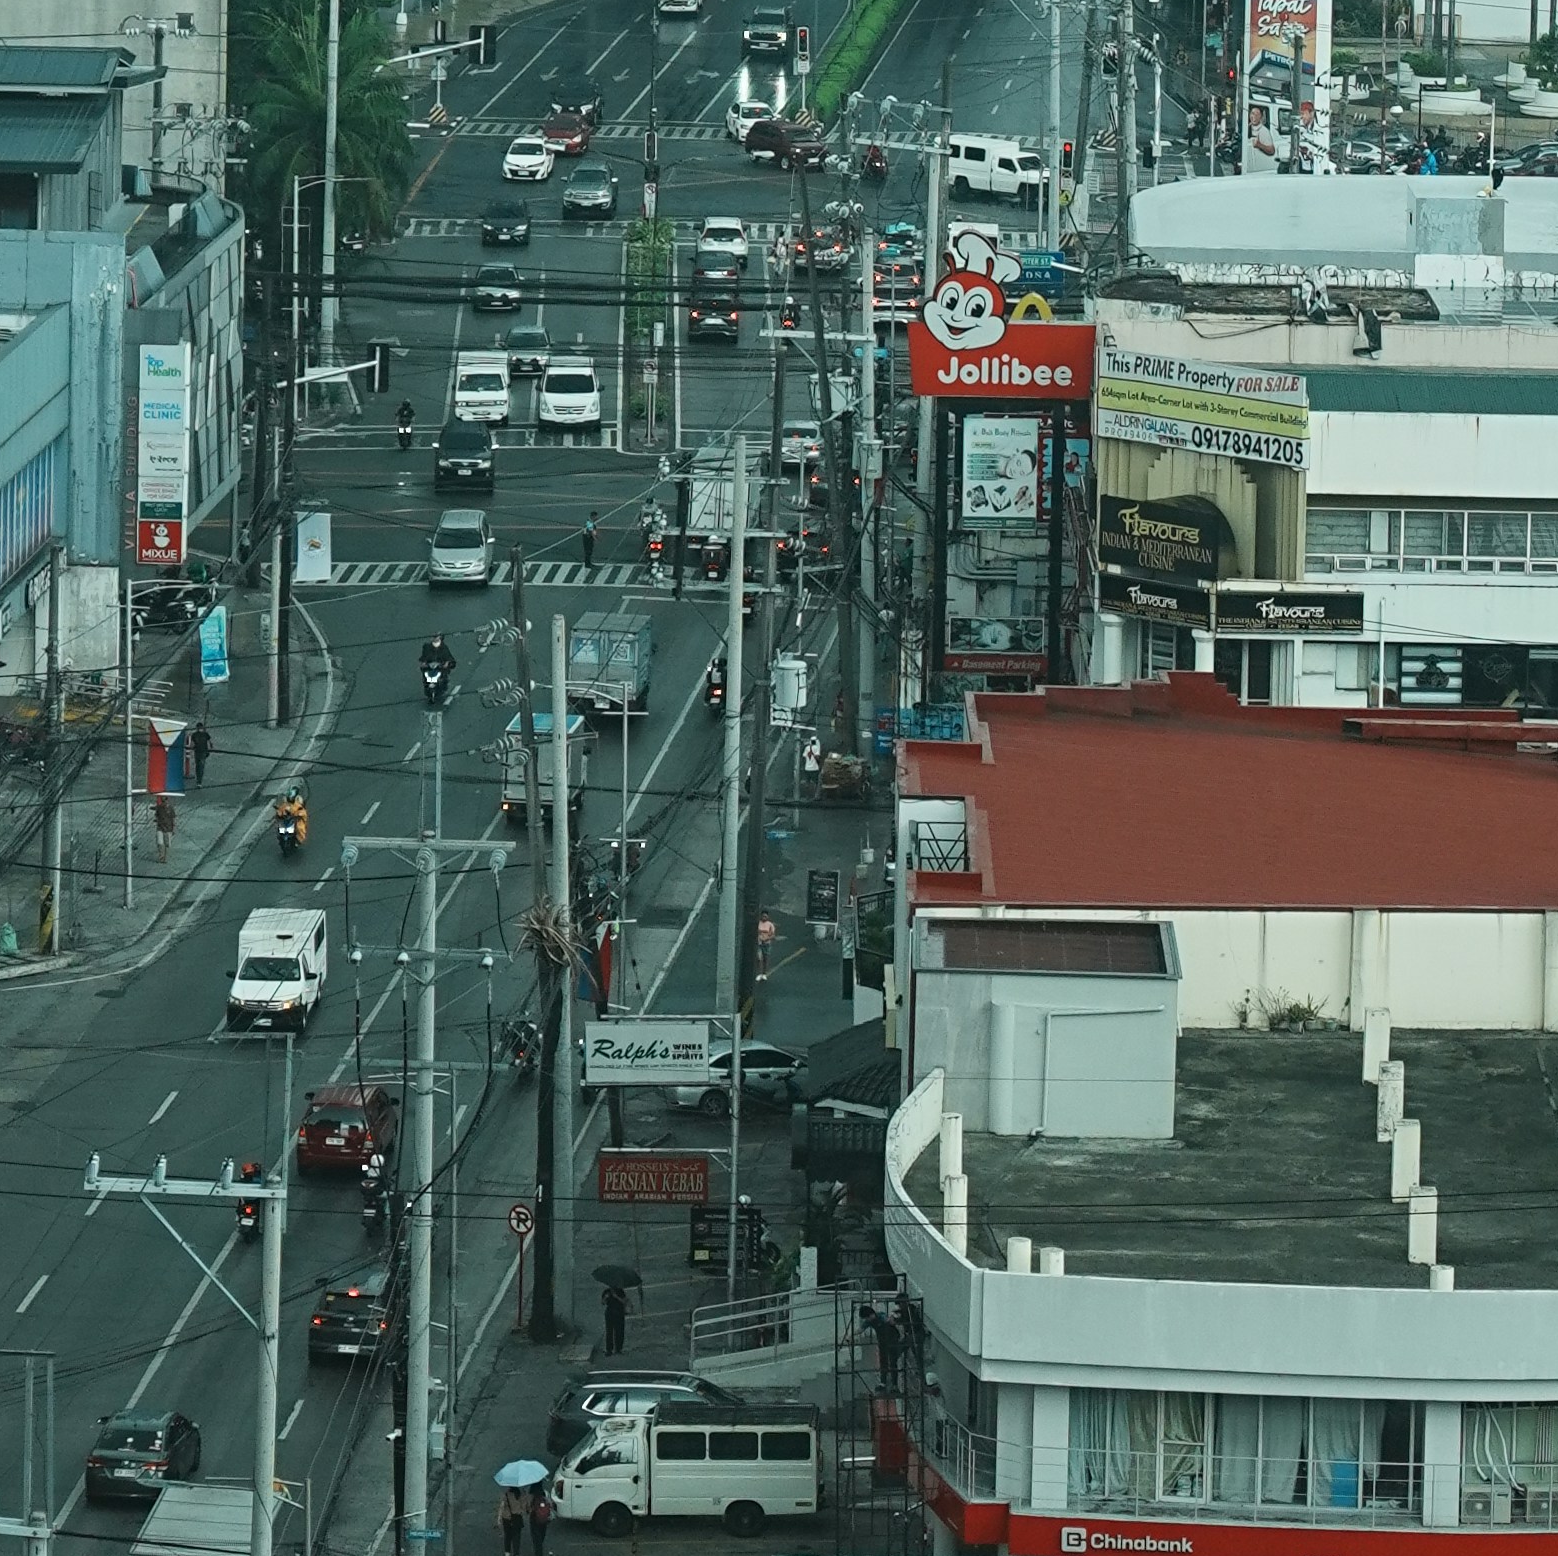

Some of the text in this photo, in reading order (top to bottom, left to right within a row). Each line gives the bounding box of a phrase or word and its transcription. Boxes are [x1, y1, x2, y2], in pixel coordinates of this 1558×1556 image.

[147, 367, 182, 377] Health
[937, 354, 1073, 386] Jollibee
[1106, 352, 1300, 394] This PRIME Property FOR SALE
[143, 402, 181, 410] MEDICAL
[143, 410, 181, 419] CLINIC
[1239, 408, 1278, 423] Commercial
[1192, 426, 1304, 465] 09178941205
[1118, 504, 1201, 544] Flavours
[142, 548, 178, 559] MIXUE
[1102, 531, 1132, 549] INDIAN
[1141, 538, 1212, 563] MEDITERRANEAN
[1138, 552, 1175, 572] CUISINE
[1127, 584, 1178, 609] Flavours
[1256, 597, 1325, 619] Flavours
[591, 1039, 670, 1064] Ralph's
[605, 1172, 704, 1192] PERSIAN KEBAB
[1090, 1533, 1193, 1554] Chinabank
